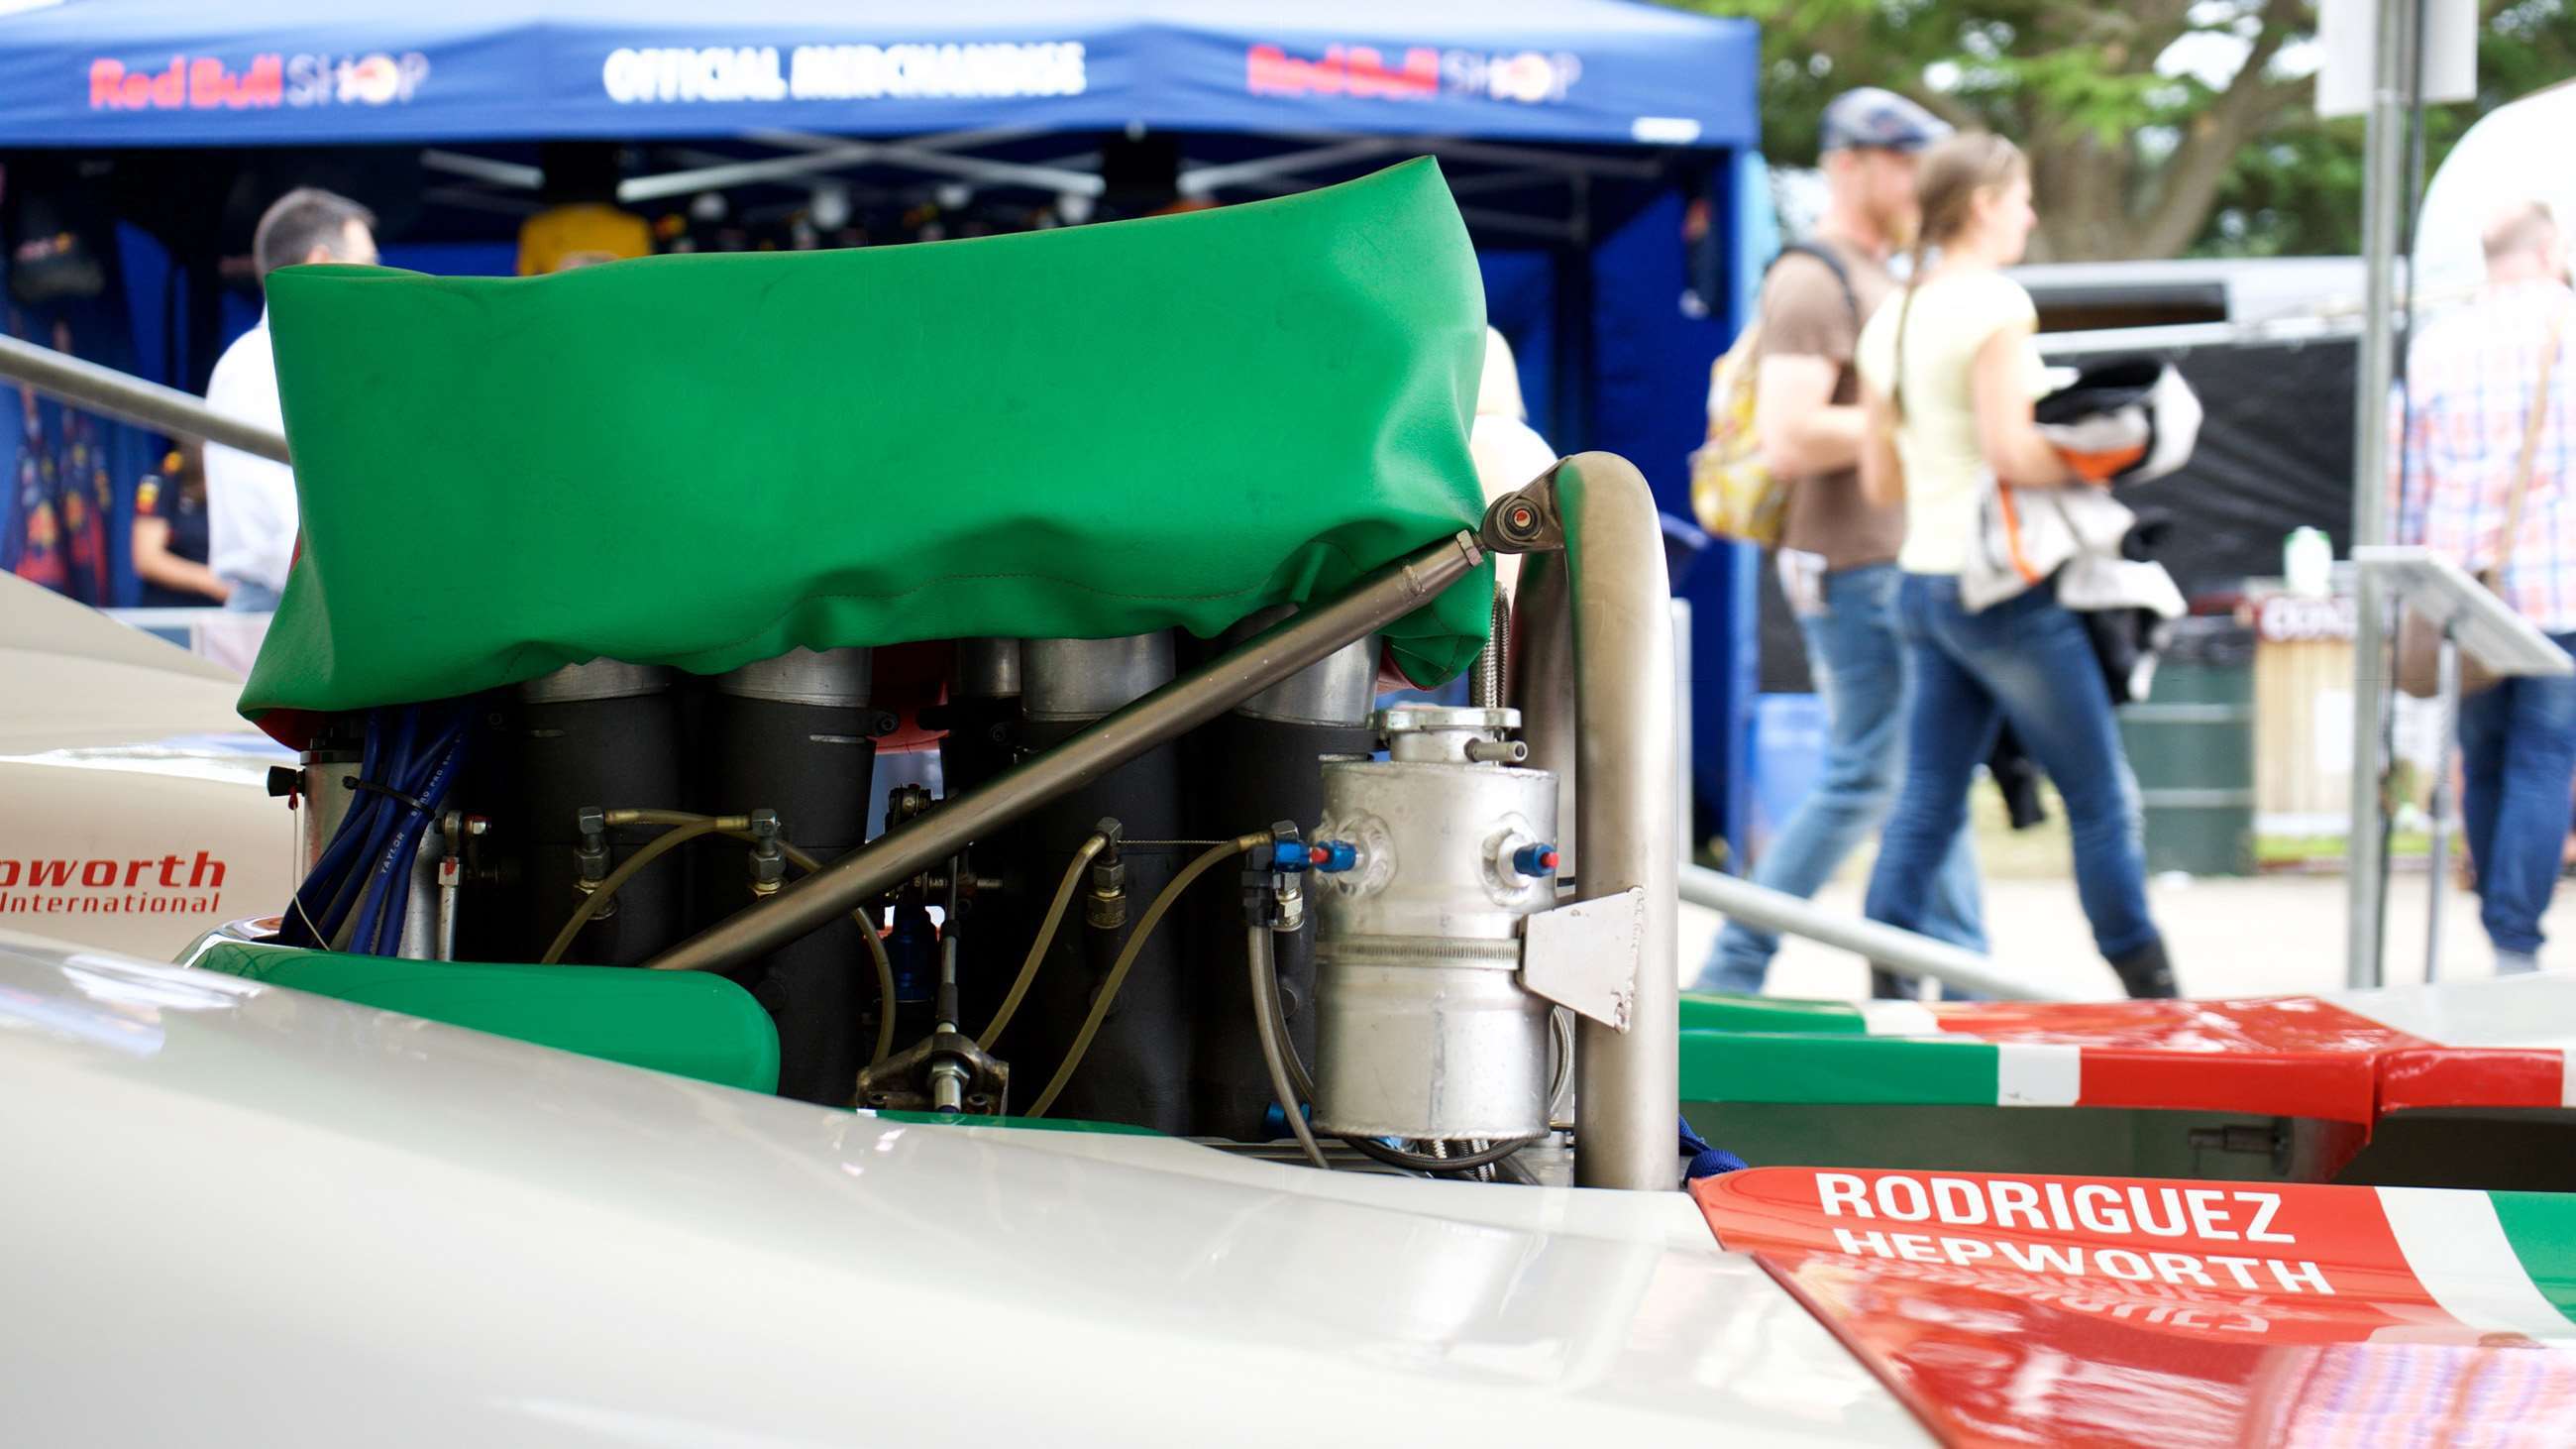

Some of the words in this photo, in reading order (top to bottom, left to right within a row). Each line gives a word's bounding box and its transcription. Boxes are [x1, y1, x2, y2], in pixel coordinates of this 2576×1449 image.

[0, 891, 221, 913] International
[1815, 1172, 2297, 1244] RODRIGUEZ
[1833, 1228, 2336, 1294] HEPWORTH
